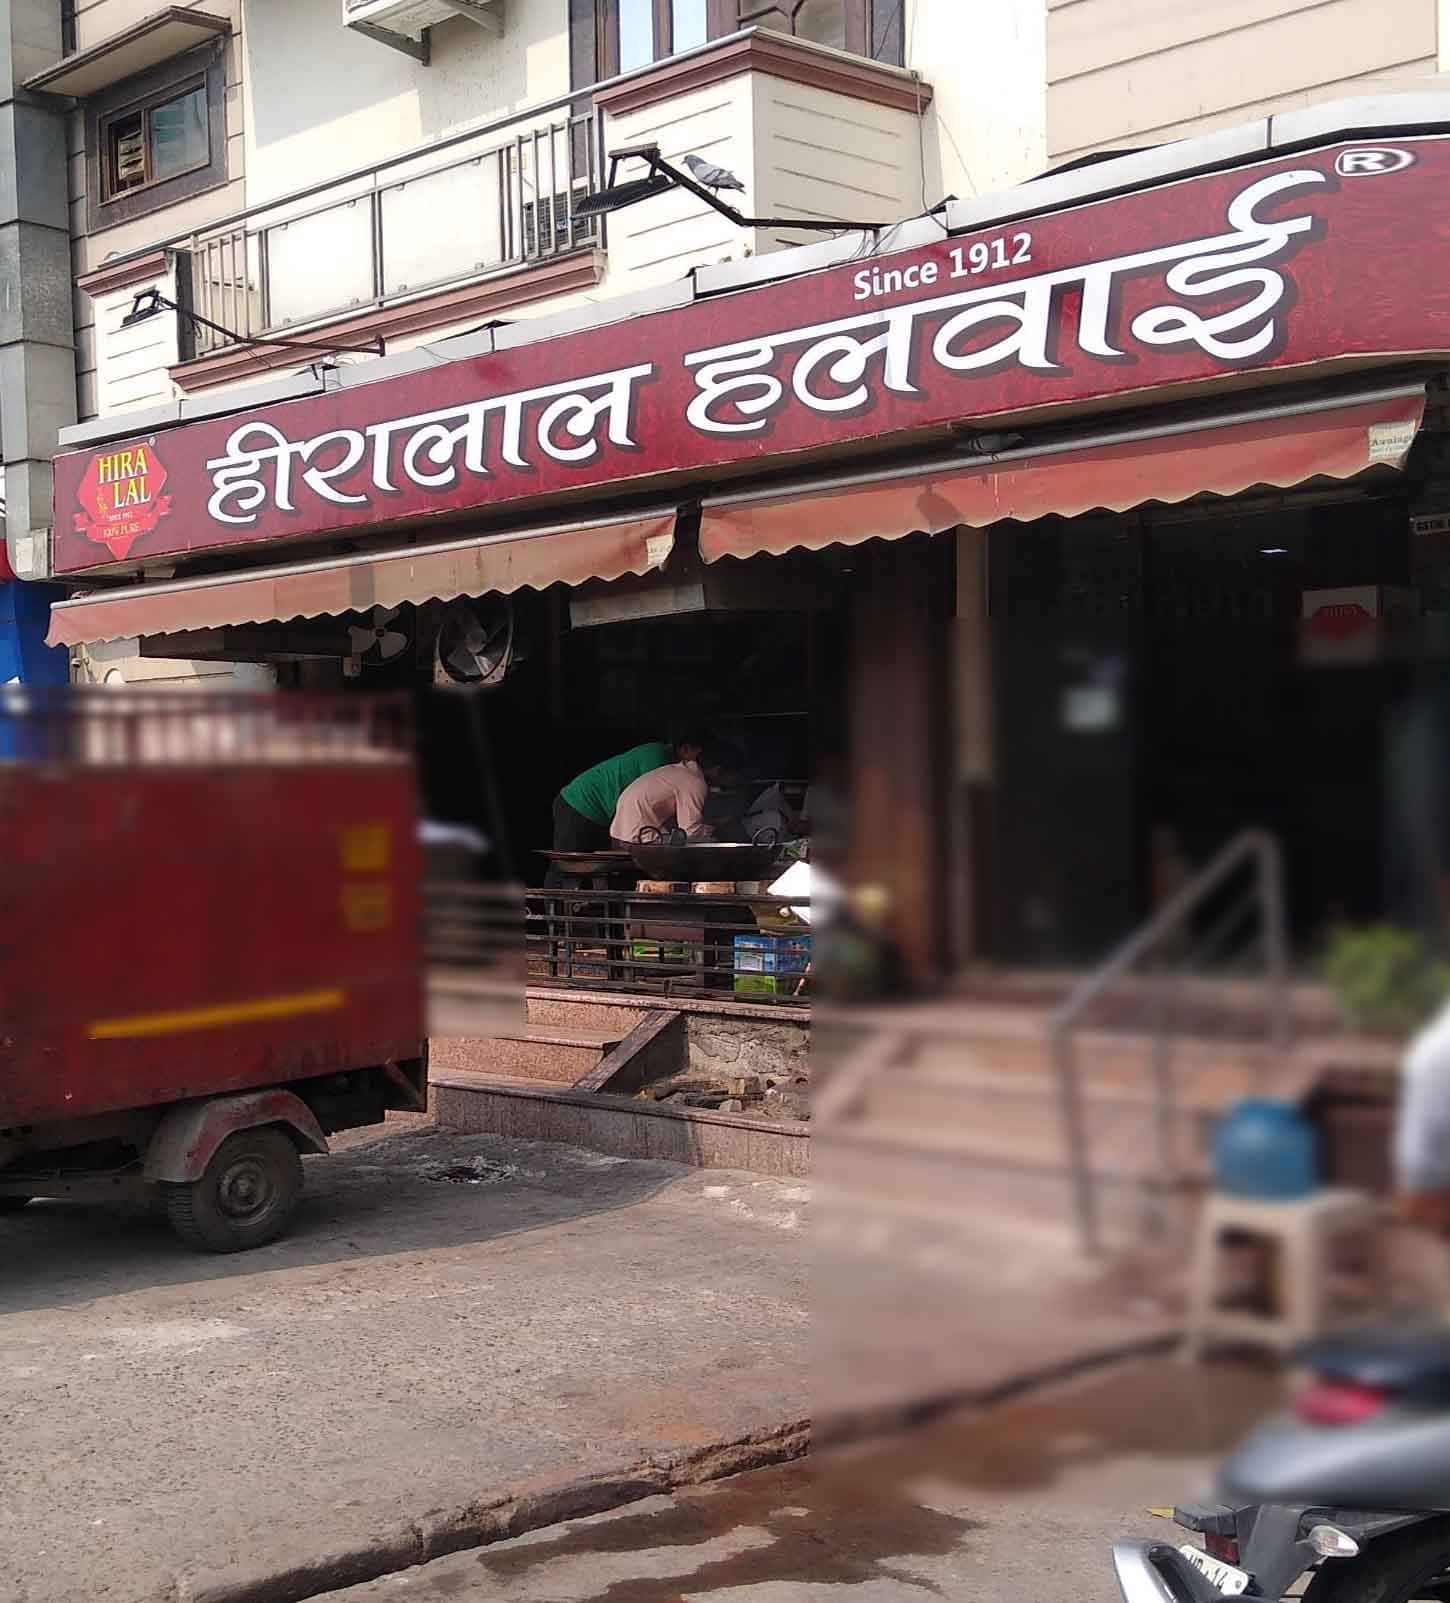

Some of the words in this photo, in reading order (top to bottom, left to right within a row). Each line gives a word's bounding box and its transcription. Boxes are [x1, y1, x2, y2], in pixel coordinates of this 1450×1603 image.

[854, 262, 938, 300] Since
[950, 232, 1032, 278] 1912
[206, 362, 654, 524] हीरालाल
[684, 170, 1326, 432] हलवाई
[97, 448, 149, 484] HIRA
[113, 476, 151, 508] LAL
